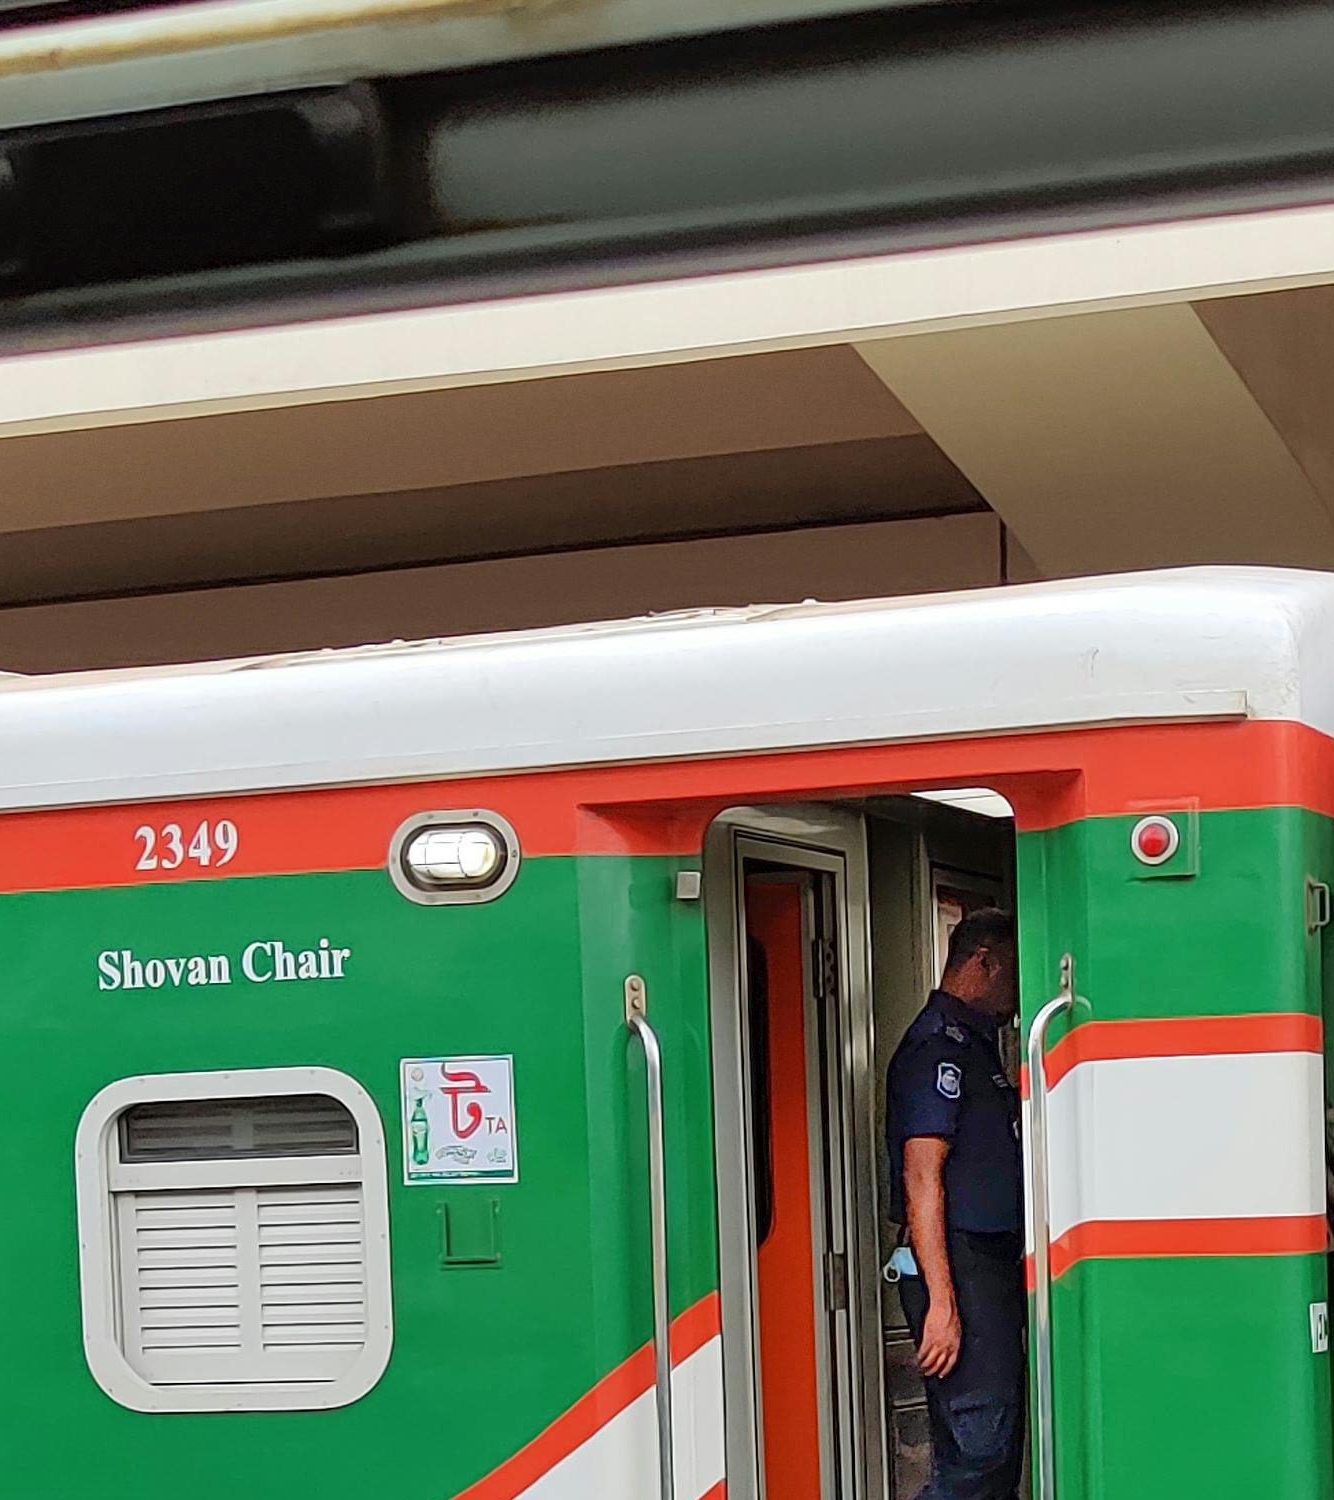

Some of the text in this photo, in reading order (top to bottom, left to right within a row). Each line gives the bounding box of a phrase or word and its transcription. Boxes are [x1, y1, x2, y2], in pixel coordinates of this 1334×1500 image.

[134, 819, 239, 870] 2349
[98, 938, 351, 990] Shovan Chair
[484, 1116, 508, 1135] TA
